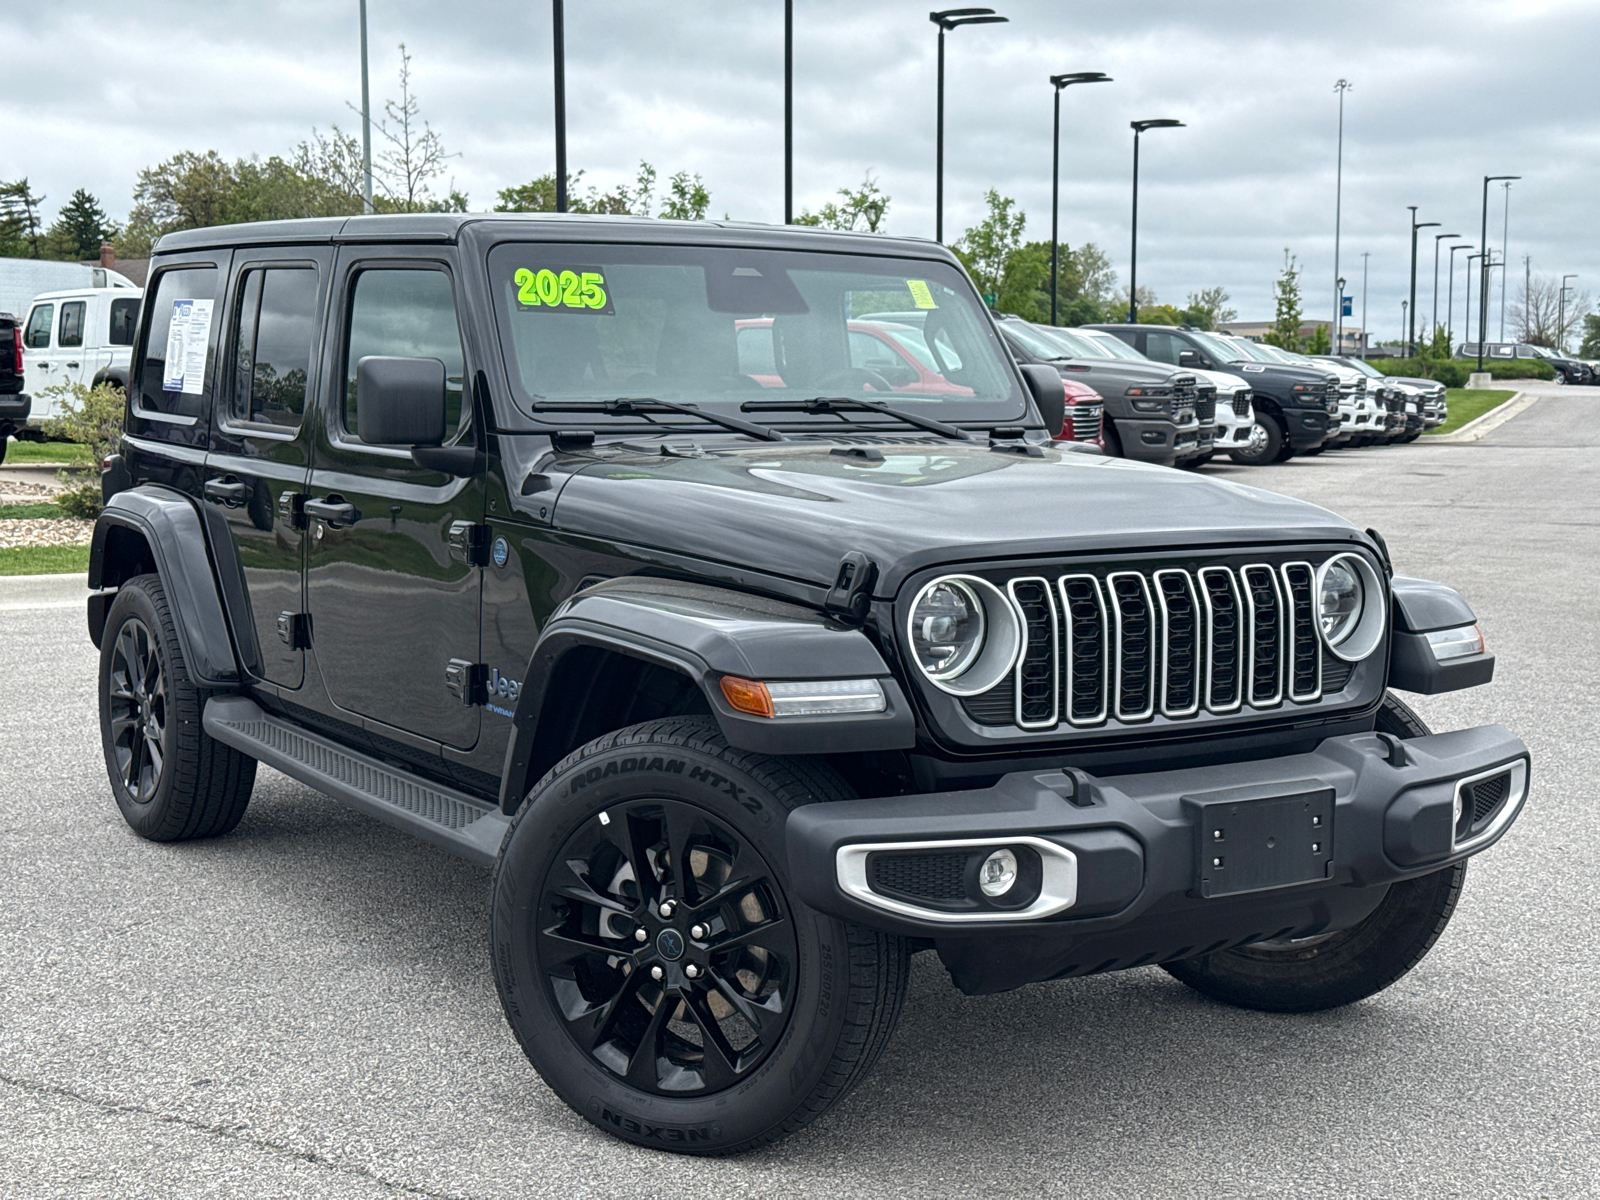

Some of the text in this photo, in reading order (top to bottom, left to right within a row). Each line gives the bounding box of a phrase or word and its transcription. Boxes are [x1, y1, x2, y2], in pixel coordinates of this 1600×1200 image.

[514, 268, 607, 310] 2025
[570, 757, 686, 794] ROADIAN
[819, 943, 833, 1018] 255/60R20
[602, 1107, 710, 1142] NEXEN
